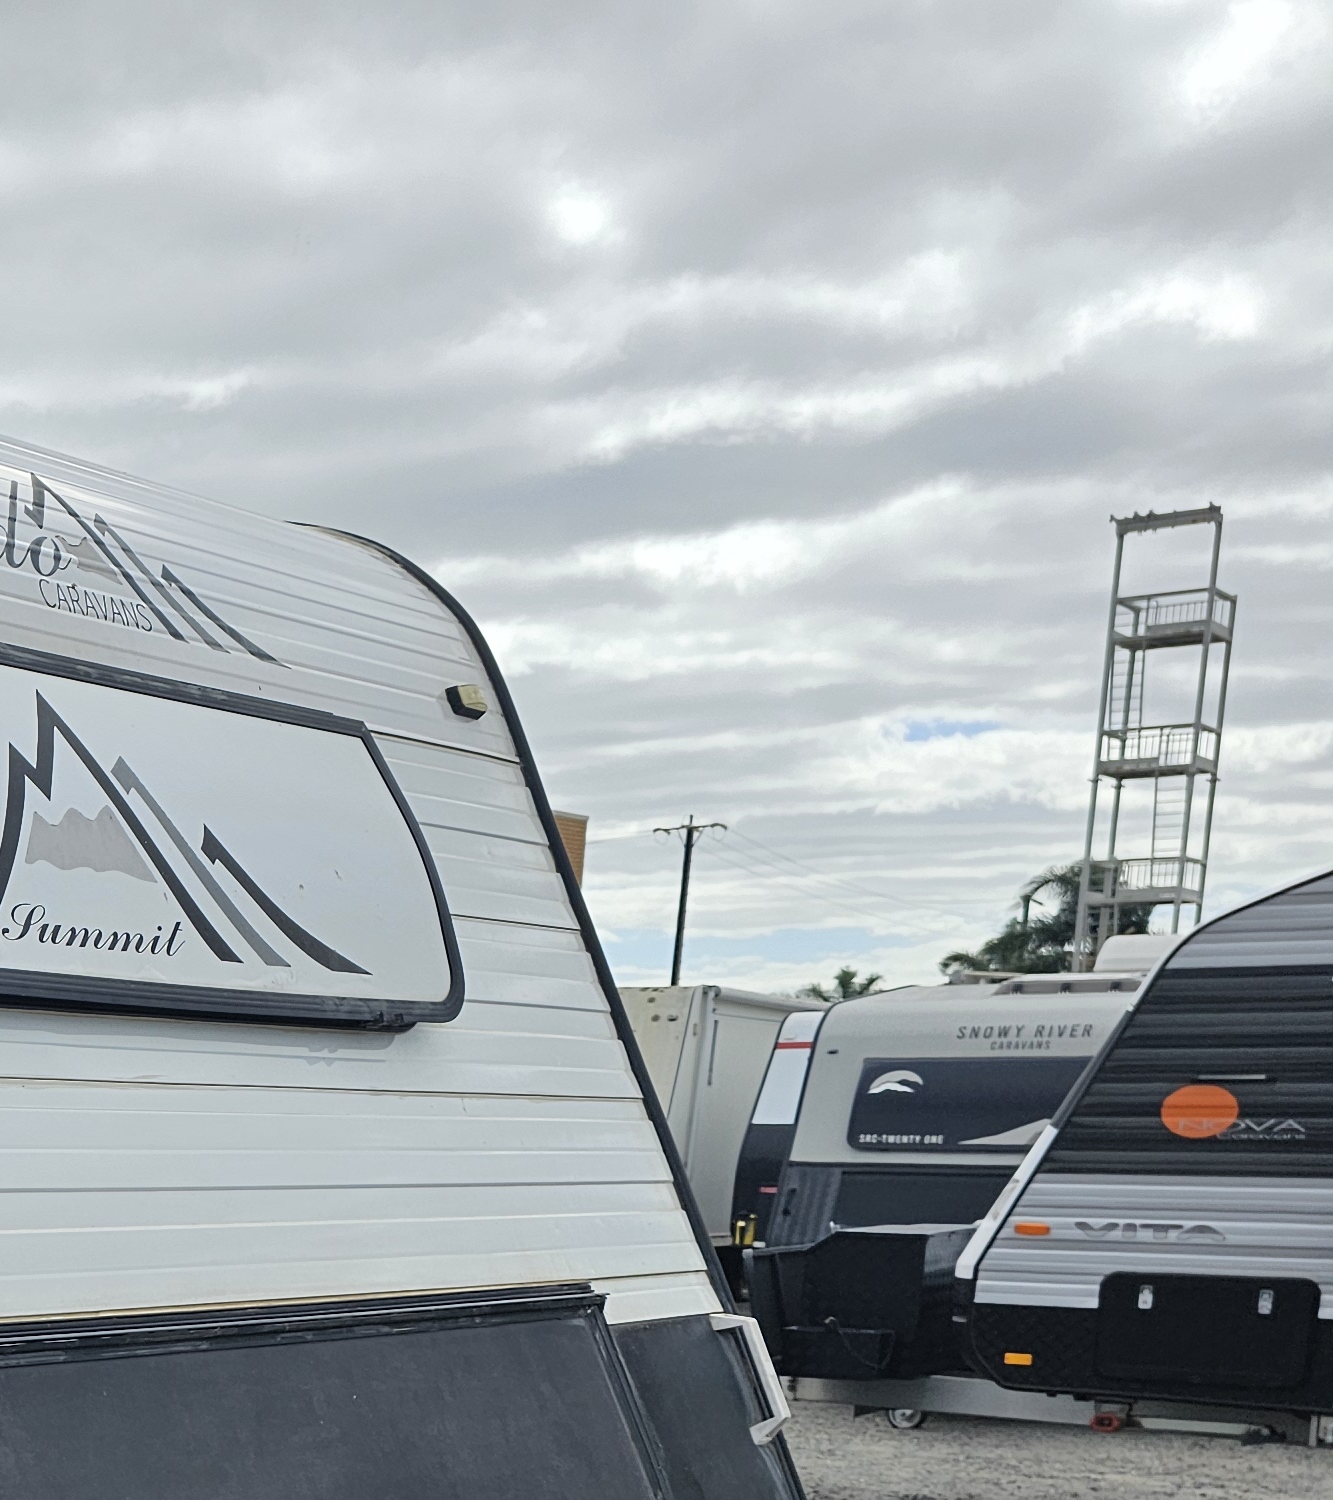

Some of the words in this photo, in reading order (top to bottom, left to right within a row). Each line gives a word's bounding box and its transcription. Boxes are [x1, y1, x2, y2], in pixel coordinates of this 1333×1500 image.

[38, 578, 153, 632] CARAVANS
[1, 902, 186, 957] Summit
[956, 1024, 1025, 1040] SNOWY
[1034, 1023, 1094, 1039] RIVER
[990, 1040, 1051, 1051] CARAVANS
[1074, 1221, 1226, 1242] VITA
